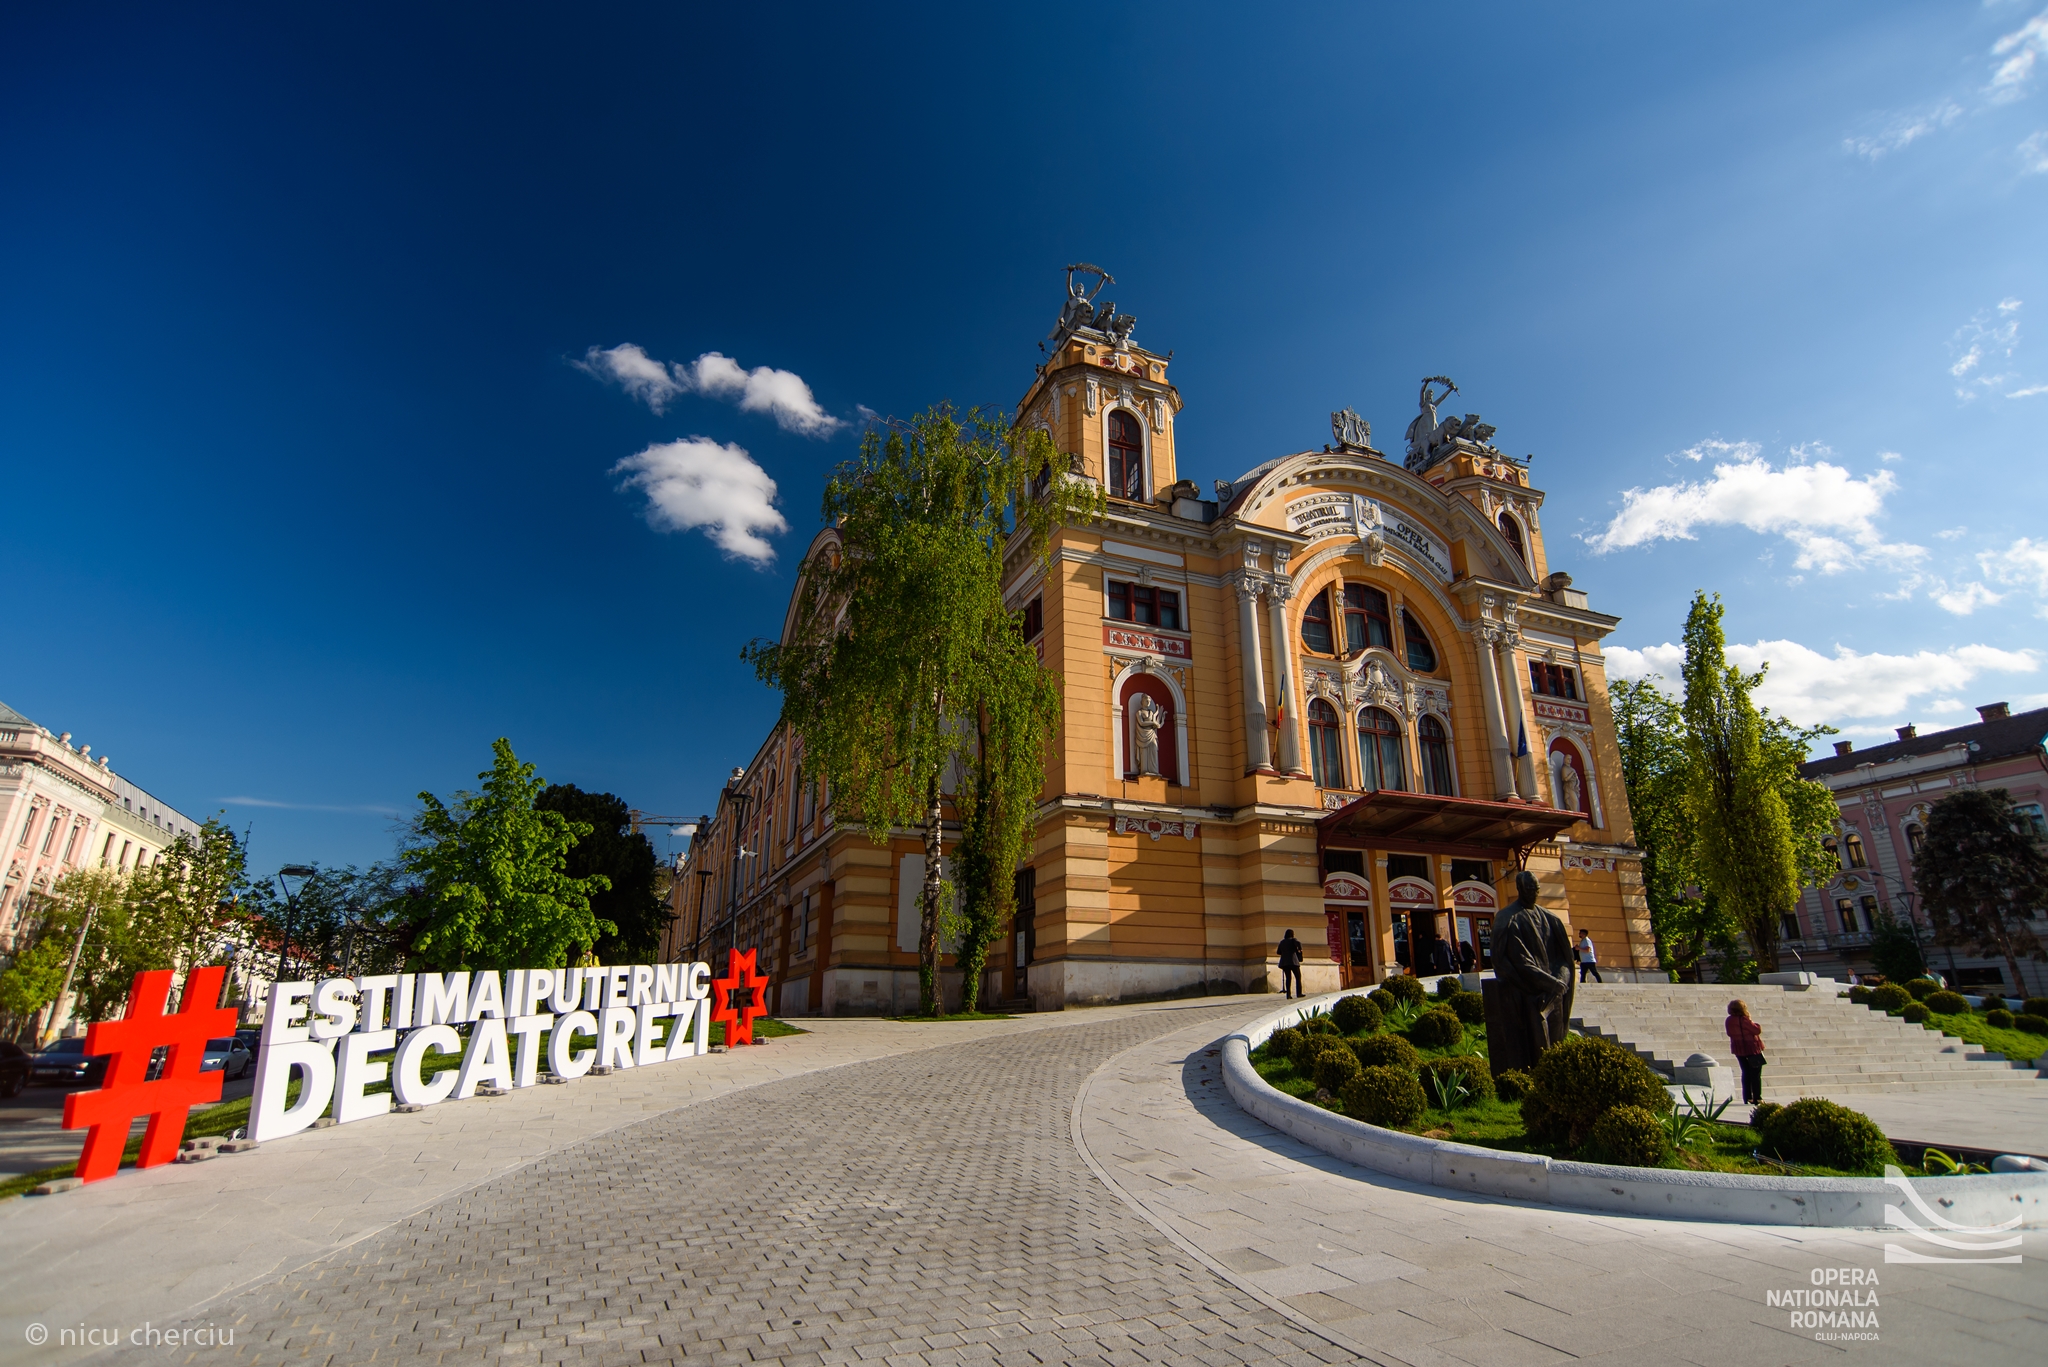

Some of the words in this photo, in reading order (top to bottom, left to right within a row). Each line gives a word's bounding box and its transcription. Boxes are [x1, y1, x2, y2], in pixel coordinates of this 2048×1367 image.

[1397, 522, 1429, 551] OPERA
[263, 961, 712, 1045] ESTIMAIPUTERNIC
[247, 998, 712, 1142] DECATCREZI
